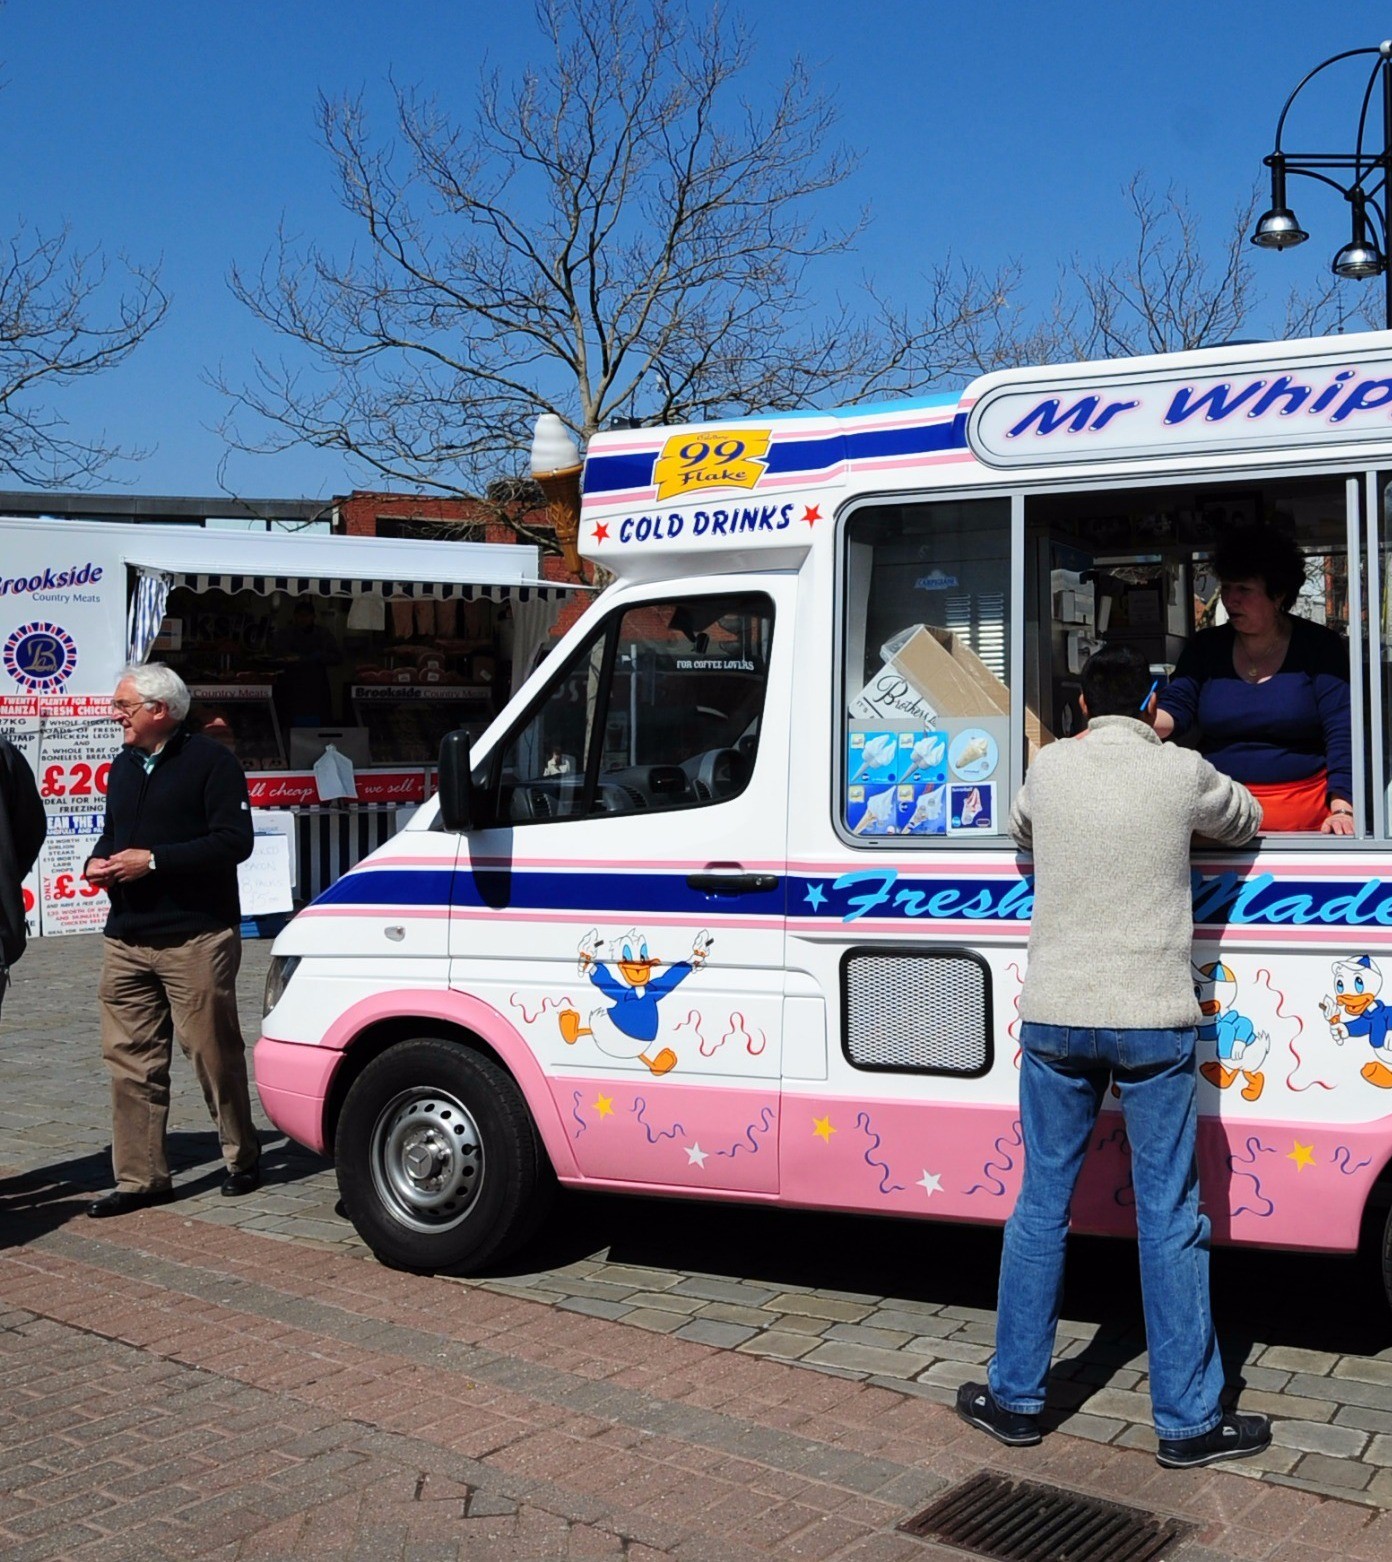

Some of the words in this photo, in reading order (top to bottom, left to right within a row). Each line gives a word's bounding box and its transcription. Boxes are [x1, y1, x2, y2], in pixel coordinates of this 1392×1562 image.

[1004, 394, 1140, 439] Mr
[679, 439, 746, 469] 99
[677, 466, 748, 486] Flake
[619, 512, 684, 544] COLD
[692, 503, 796, 537] DRINKS
[32, 592, 70, 604] Country
[73, 594, 101, 603] Meats
[676, 660, 692, 669] FOR
[694, 660, 722, 669] COFFEE
[354, 686, 421, 698] Brookside
[41, 705, 74, 717] FRESH
[77, 705, 113, 715] CHICKE
[269, 781, 315, 802] cheap
[364, 783, 384, 794] we
[387, 778, 415, 794] sell
[59, 805, 104, 813] FREEZING
[47, 816, 70, 828] EAN
[74, 816, 94, 828] THE
[44, 876, 52, 901] ONLY
[53, 873, 107, 901] £3
[831, 867, 1036, 924] Fresh
